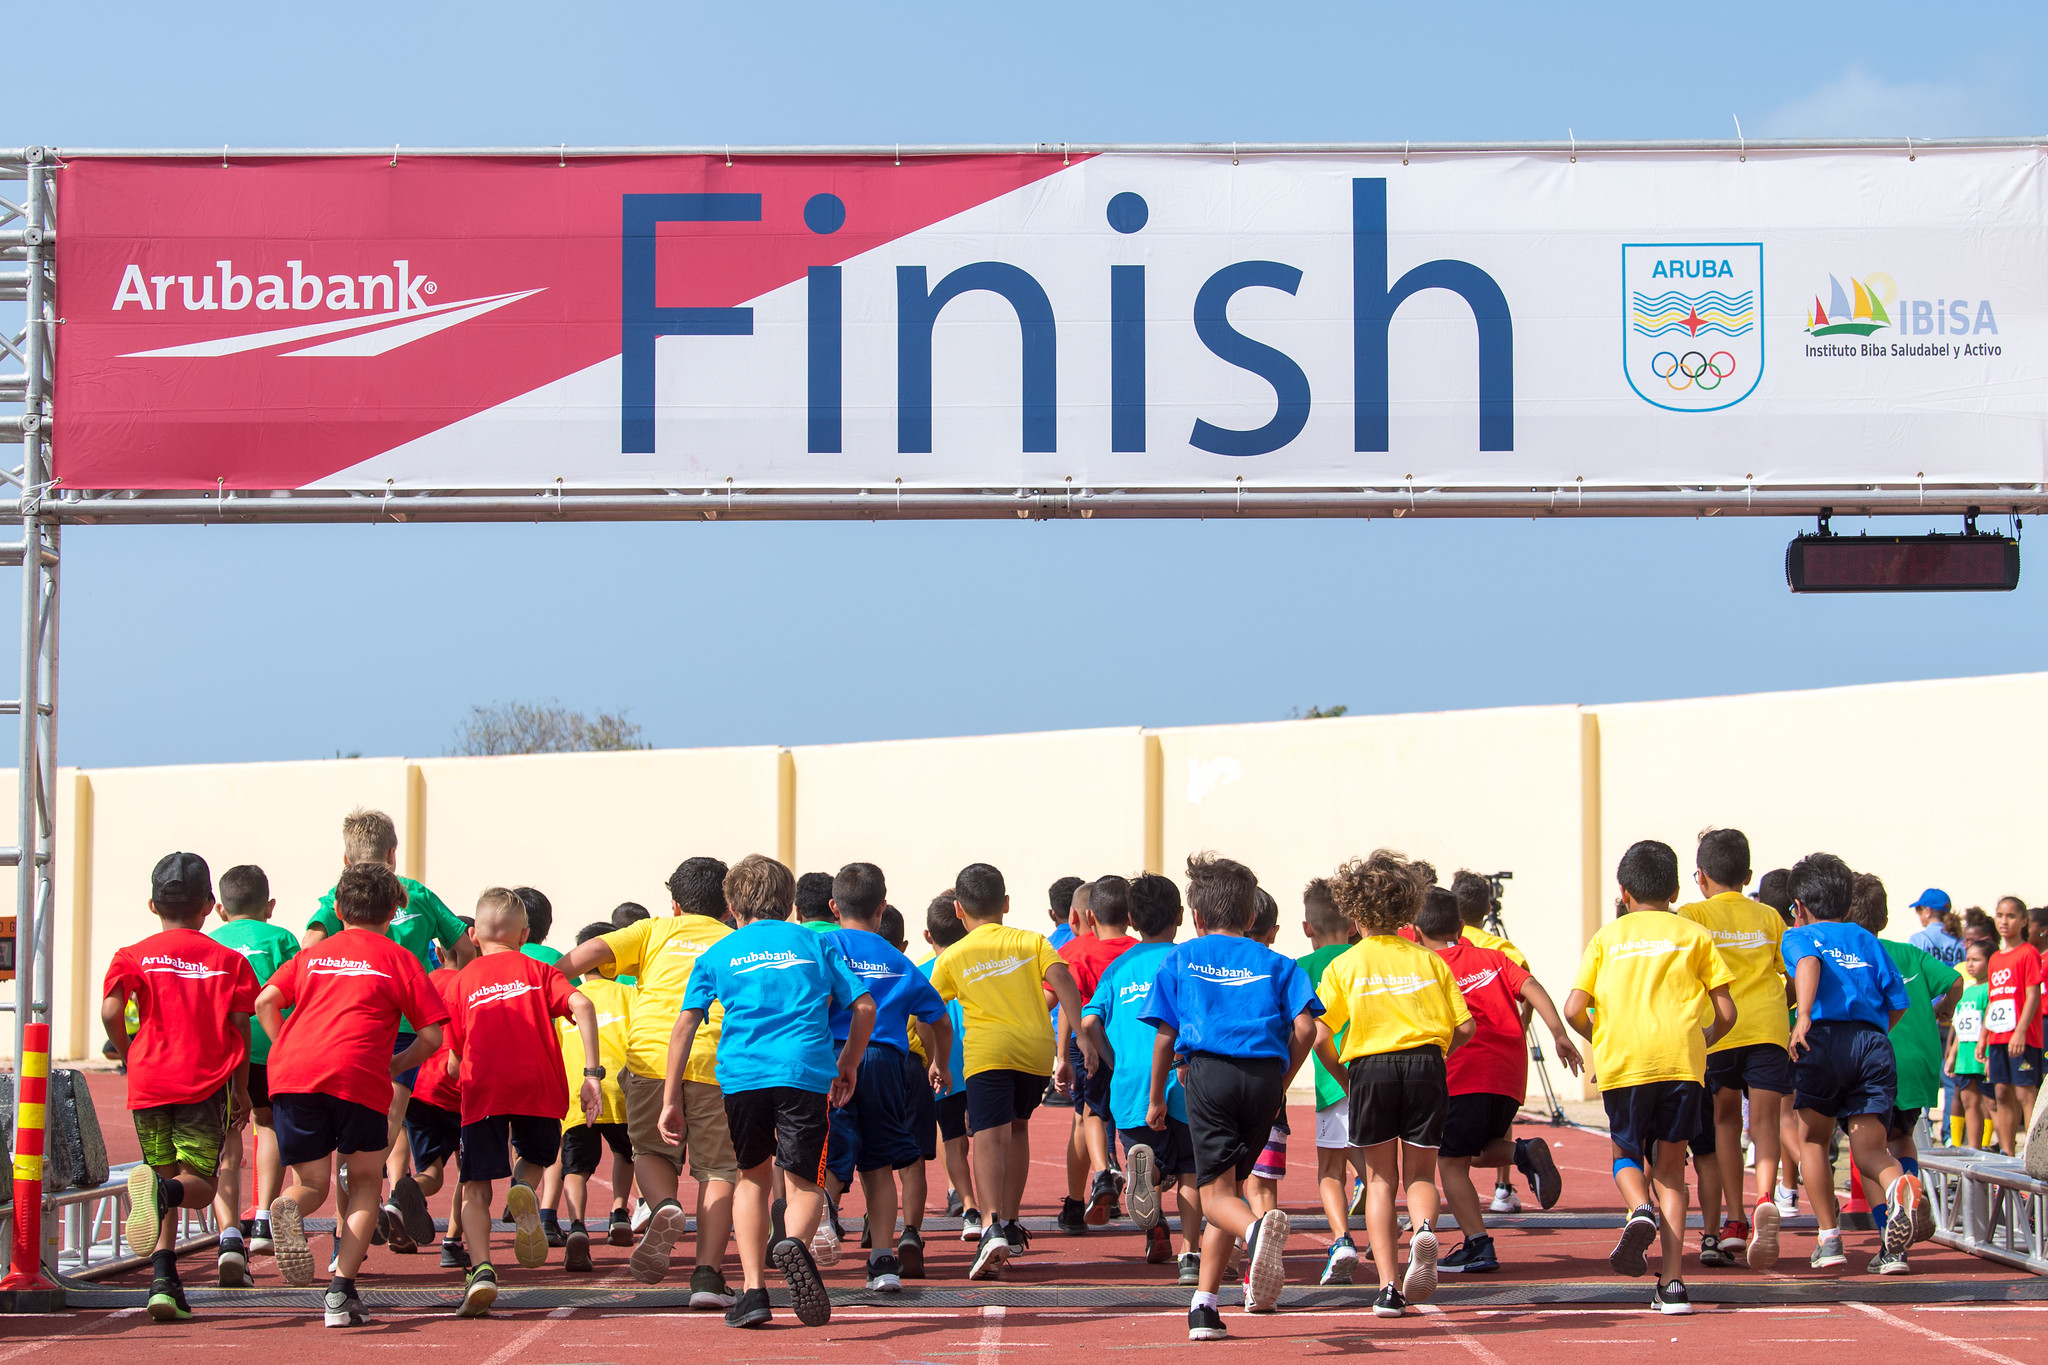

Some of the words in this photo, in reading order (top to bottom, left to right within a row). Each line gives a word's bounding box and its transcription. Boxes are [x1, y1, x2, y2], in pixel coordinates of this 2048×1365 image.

[1652, 259, 1734, 278] ARUBA
[621, 178, 1513, 456] Finish
[1900, 299, 1998, 336] IBiSA
[1805, 343, 1857, 358] Instituto
[1861, 343, 1887, 358] Biba
[1891, 343, 1950, 358] Saludabel
[1953, 347, 1961, 359] y
[1964, 343, 2002, 358] Activo
[665, 938, 710, 951] Arubab
[142, 955, 209, 973] Arubabank
[729, 950, 798, 968] Arubabank
[962, 955, 1019, 979] Arubabank
[1188, 962, 1254, 978] Arubabank
[1353, 972, 1421, 988] Arubabank
[1120, 981, 1152, 998] Arubab
[1990, 1007, 2006, 1022] 62
[1958, 1017, 1972, 1030] 65
